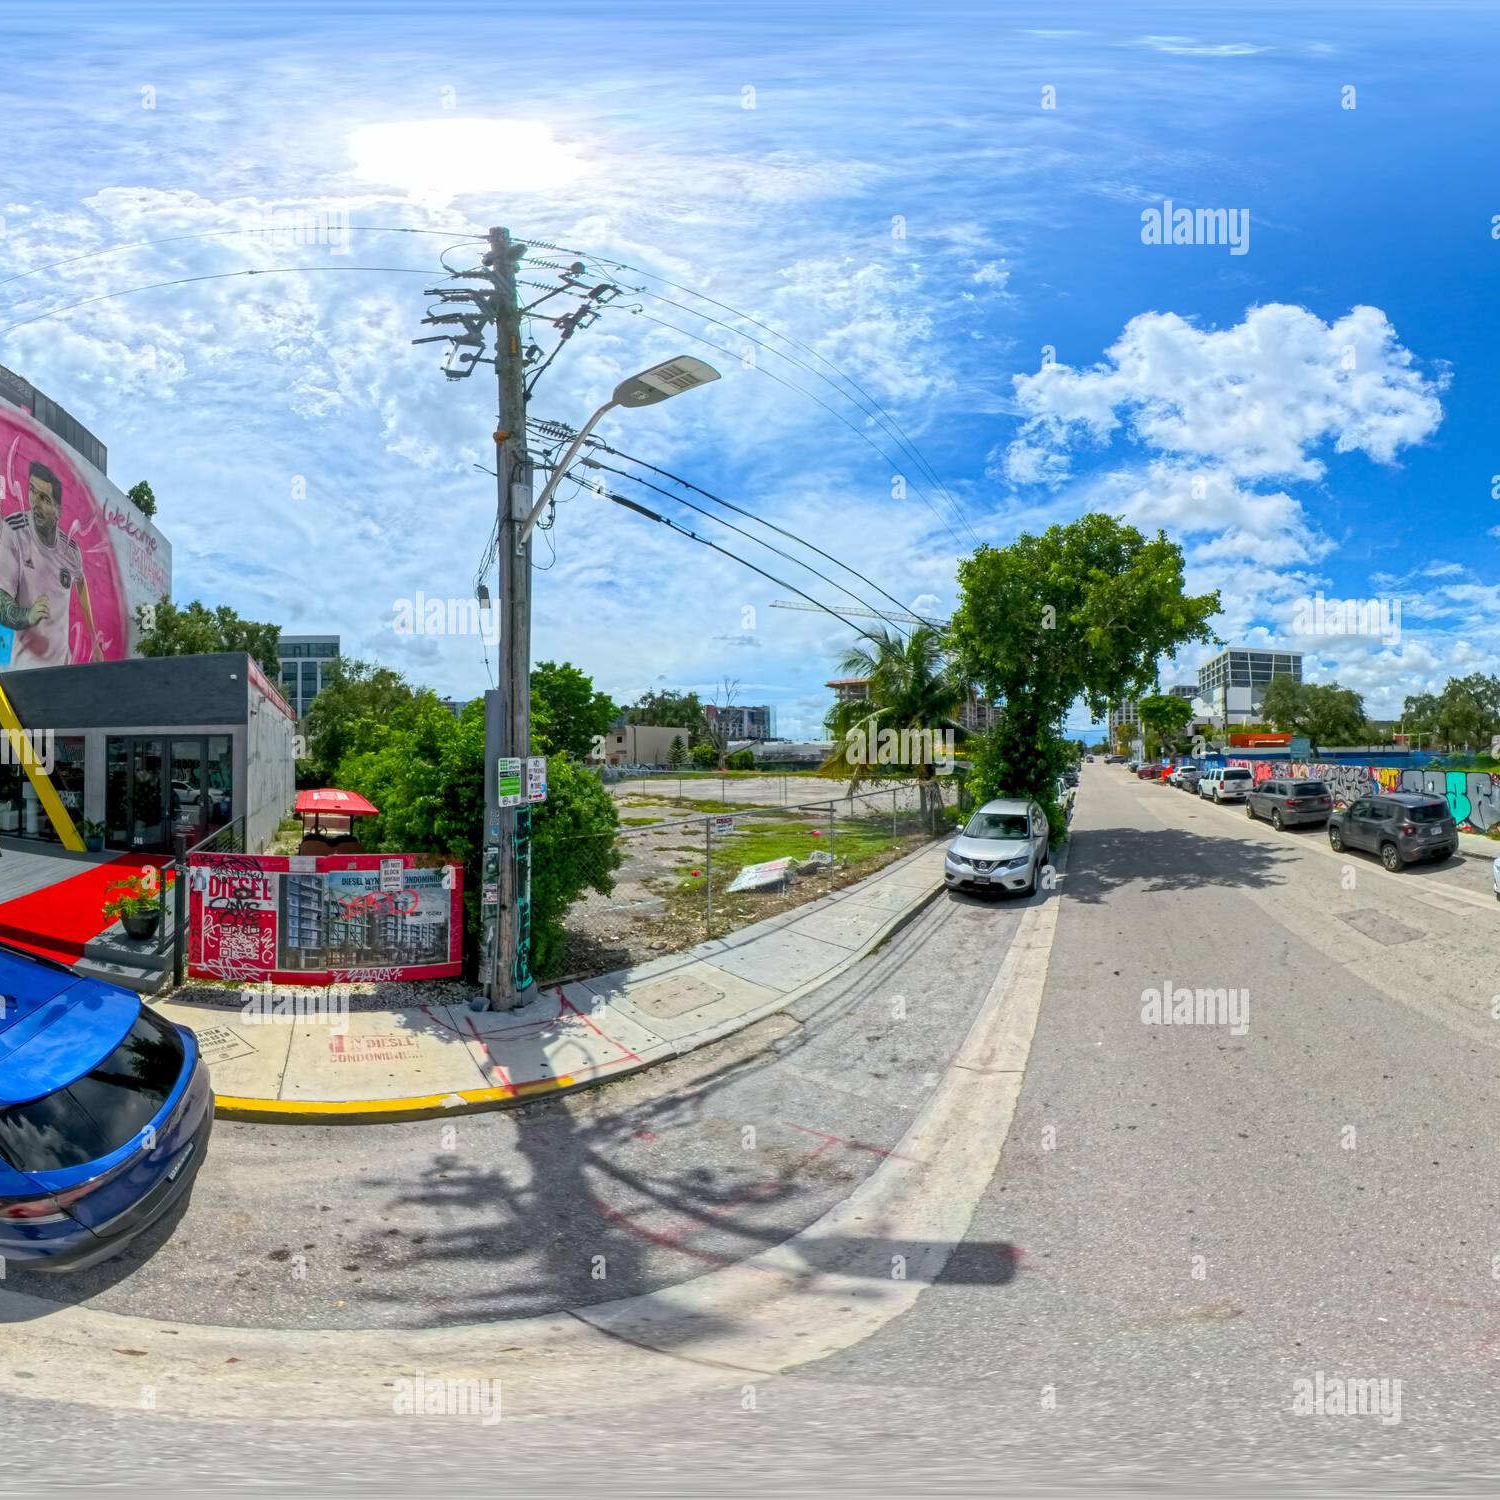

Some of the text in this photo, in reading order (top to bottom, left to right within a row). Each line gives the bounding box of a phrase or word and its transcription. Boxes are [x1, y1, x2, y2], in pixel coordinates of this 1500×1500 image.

[102, 497, 158, 551] Welcome
[208, 876, 272, 900] DIESEL
[341, 877, 364, 886] DIESEL
